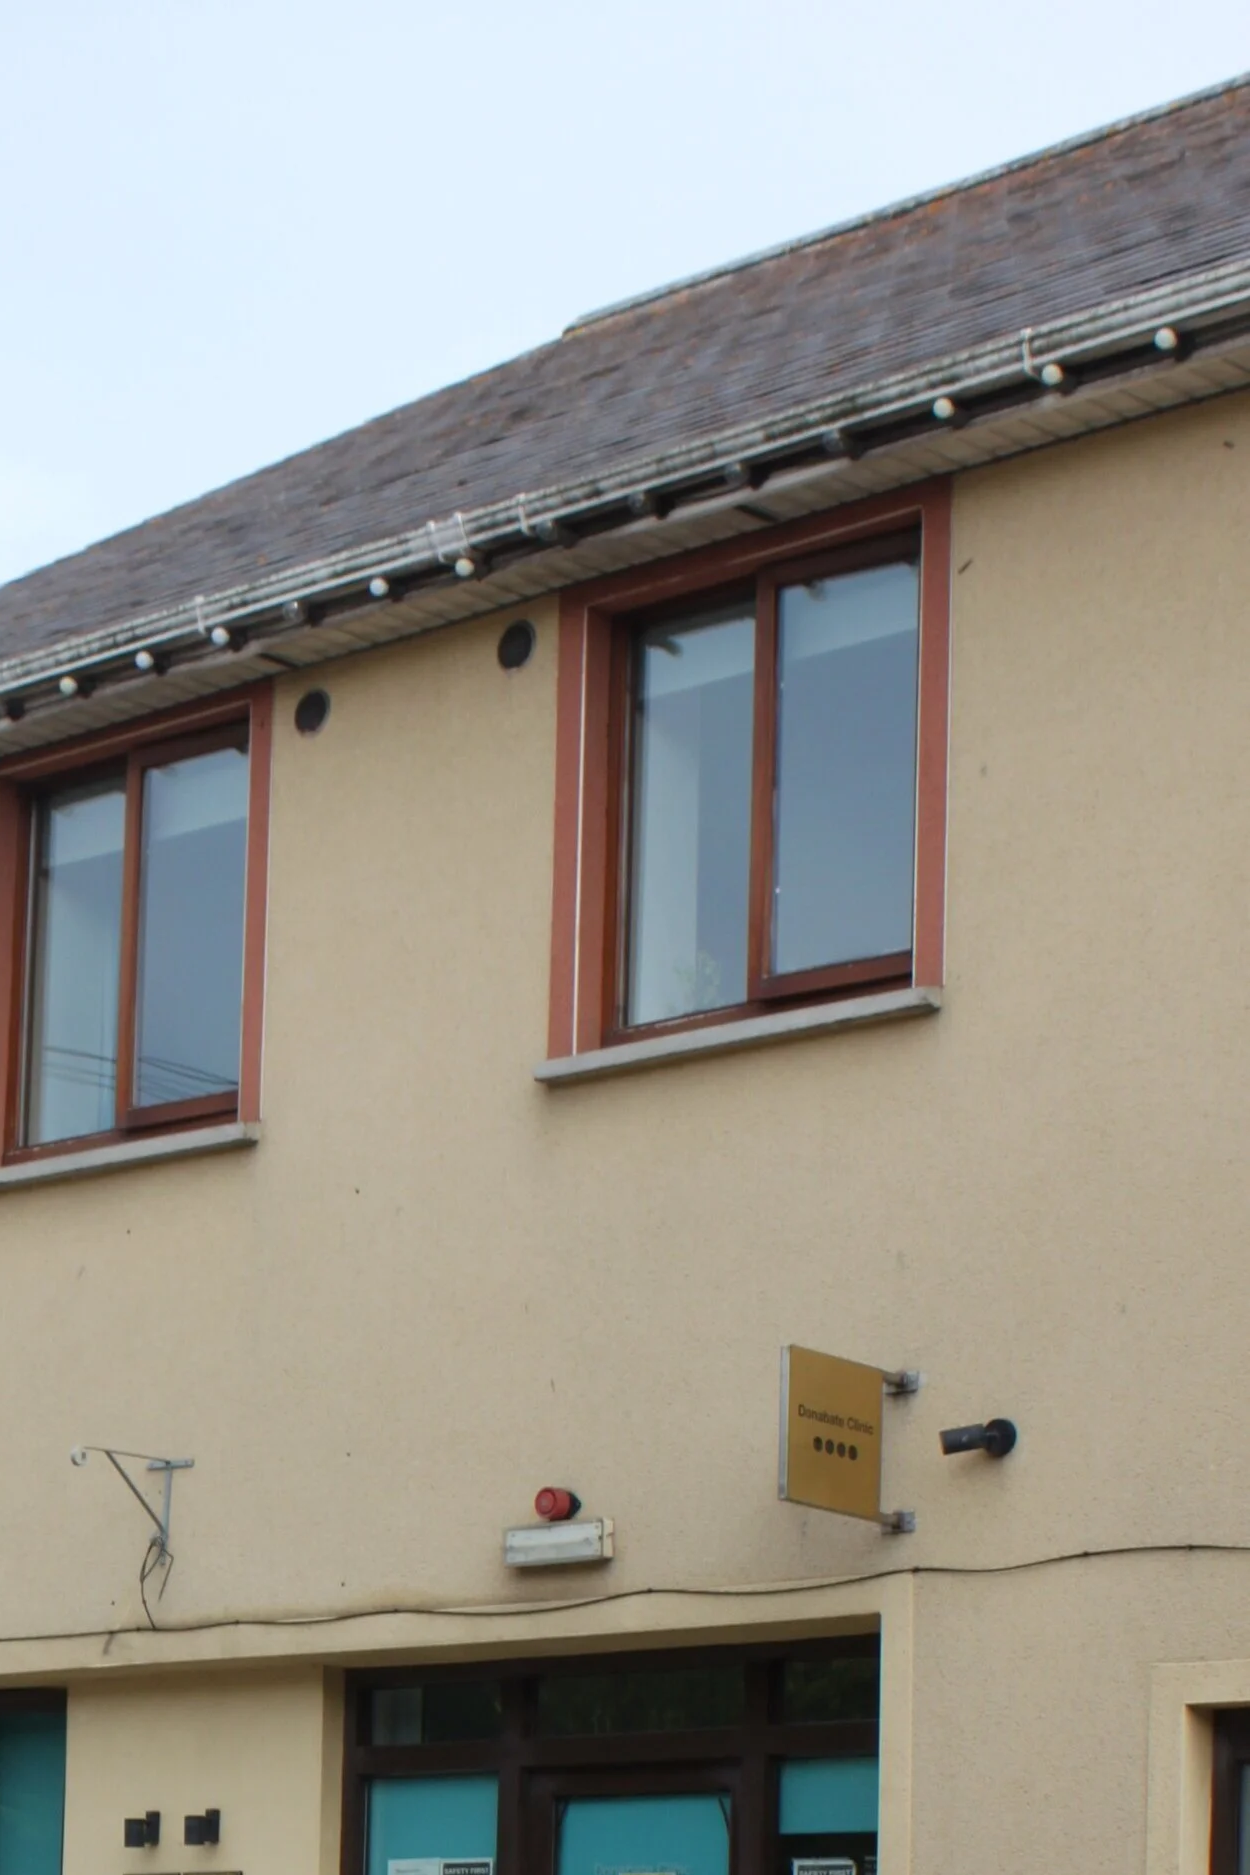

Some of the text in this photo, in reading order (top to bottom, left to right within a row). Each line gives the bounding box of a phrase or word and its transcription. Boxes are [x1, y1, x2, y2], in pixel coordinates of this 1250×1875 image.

[797, 1404, 874, 1436] Donabate Clinic
[444, 1866, 489, 1875] SAFETY FIRST
